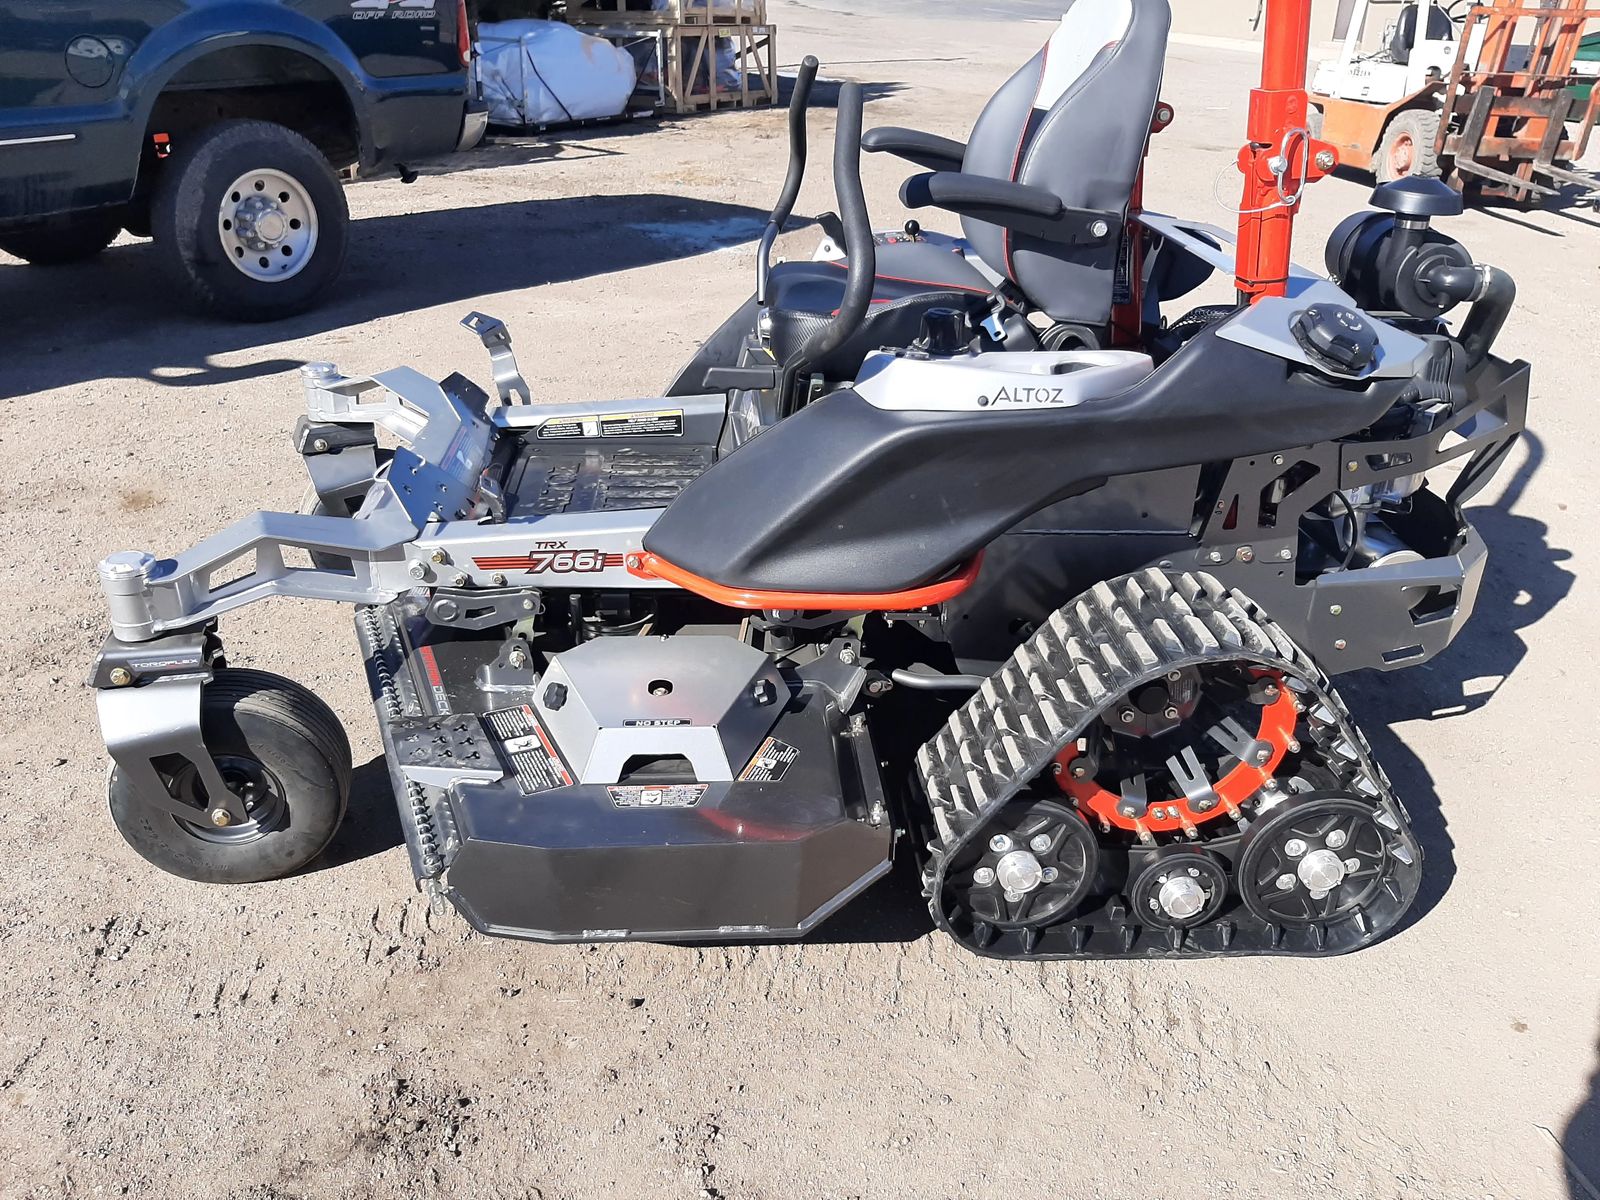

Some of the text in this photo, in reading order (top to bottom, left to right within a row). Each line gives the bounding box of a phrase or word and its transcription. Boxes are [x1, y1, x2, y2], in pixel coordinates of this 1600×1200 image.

[352, 10, 436, 20] OFF ROAD
[990, 385, 1065, 406] ALTOZ
[535, 540, 569, 550] TRX
[527, 550, 605, 574] 766i
[432, 685, 452, 716] DECK
